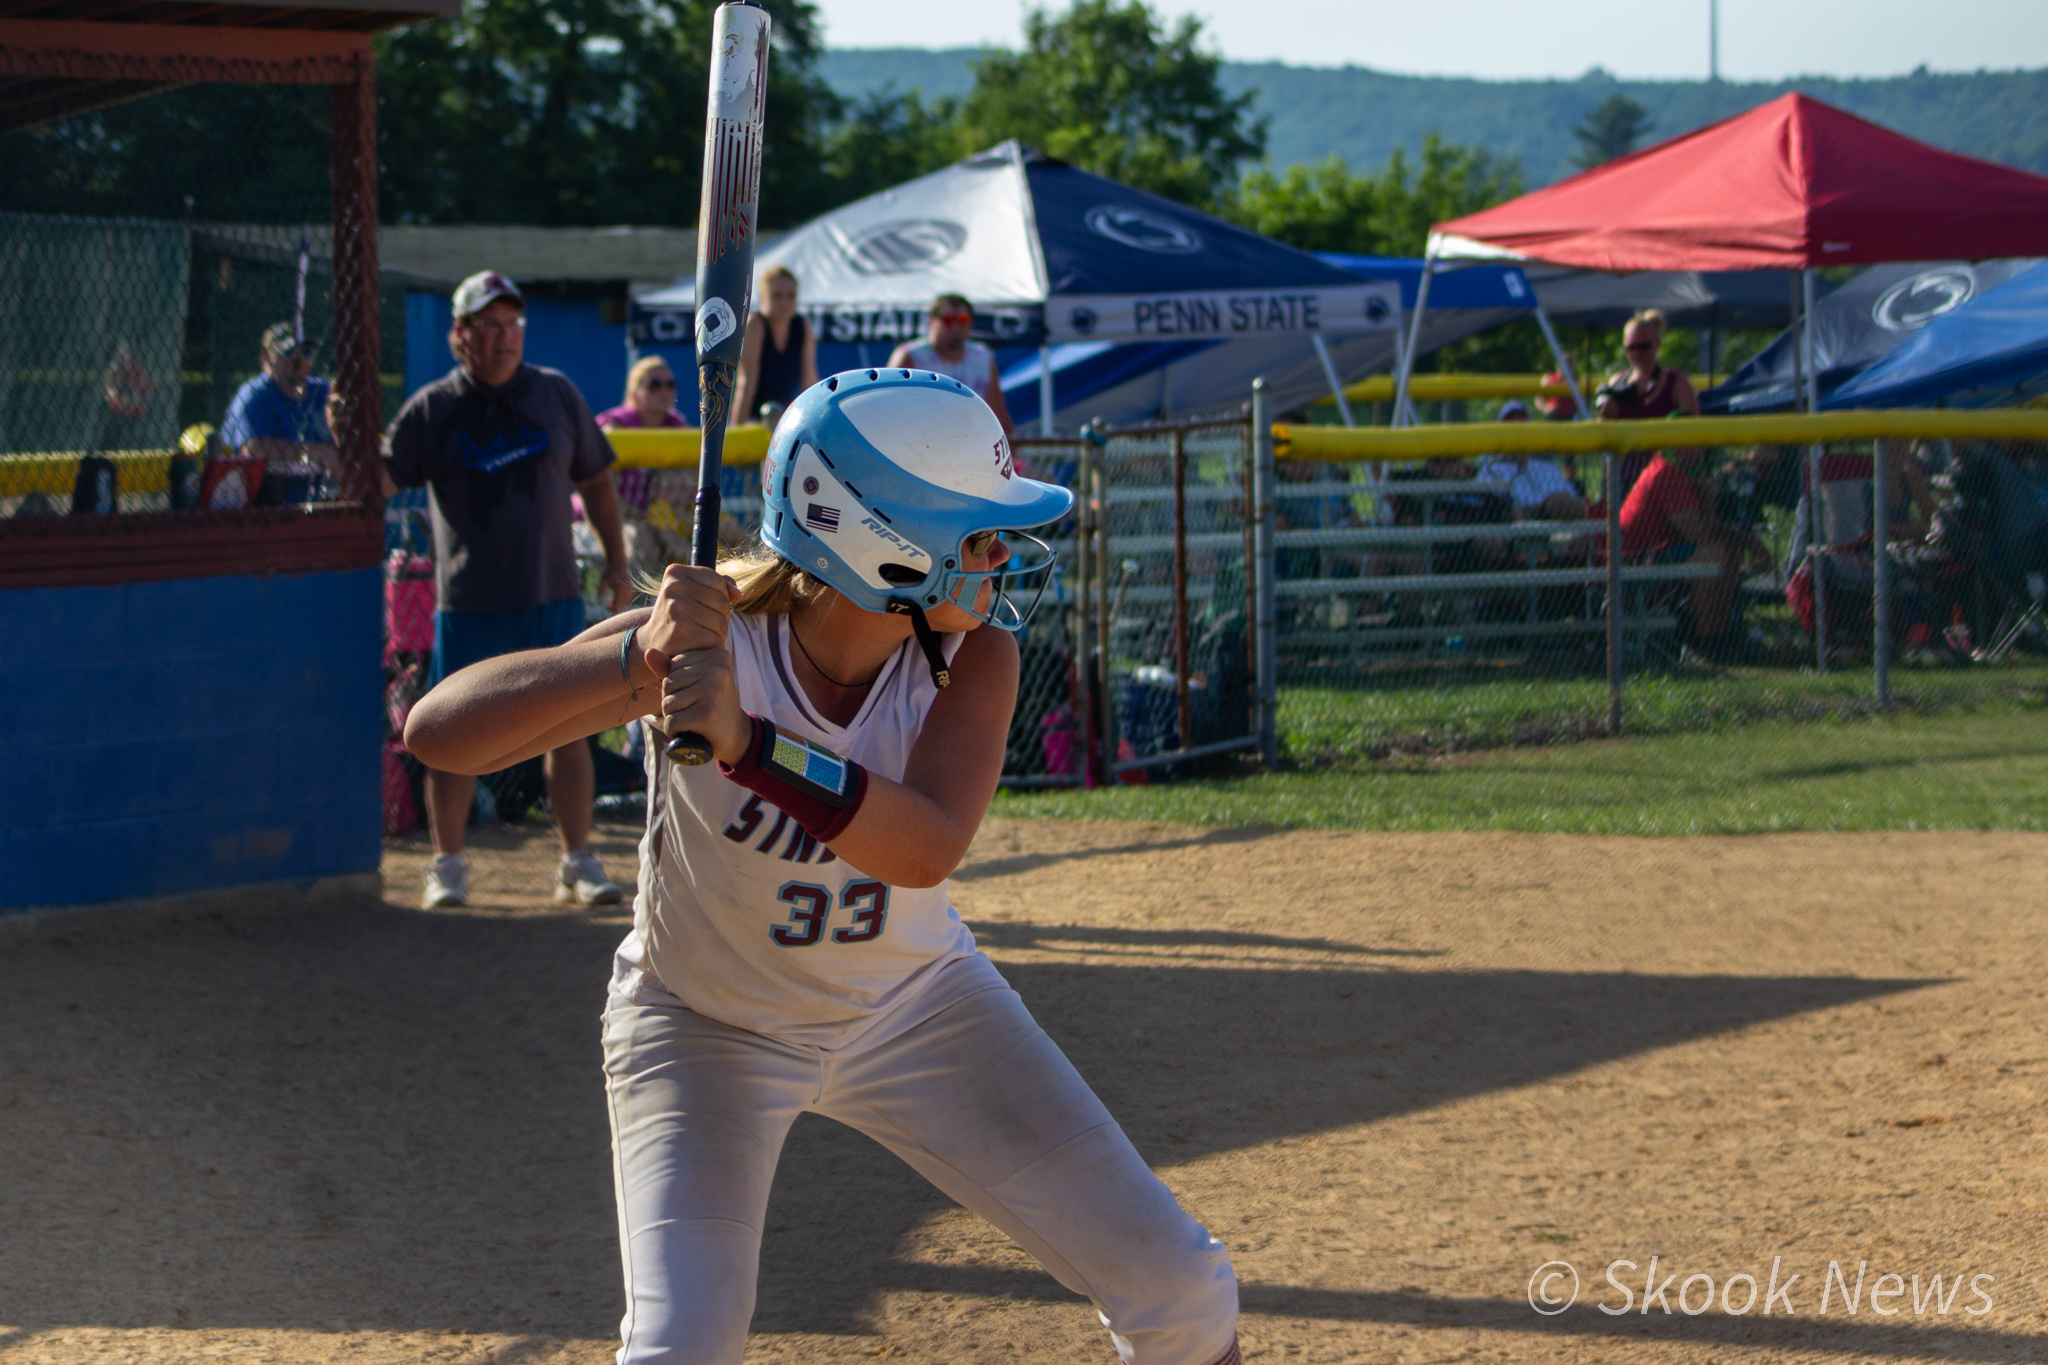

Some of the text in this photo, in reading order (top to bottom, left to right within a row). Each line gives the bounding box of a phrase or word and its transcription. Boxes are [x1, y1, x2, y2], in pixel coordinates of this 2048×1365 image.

[1133, 295, 1319, 334] PENN STATE
[860, 517, 926, 558] RIP-IT
[769, 878, 891, 948] 33
